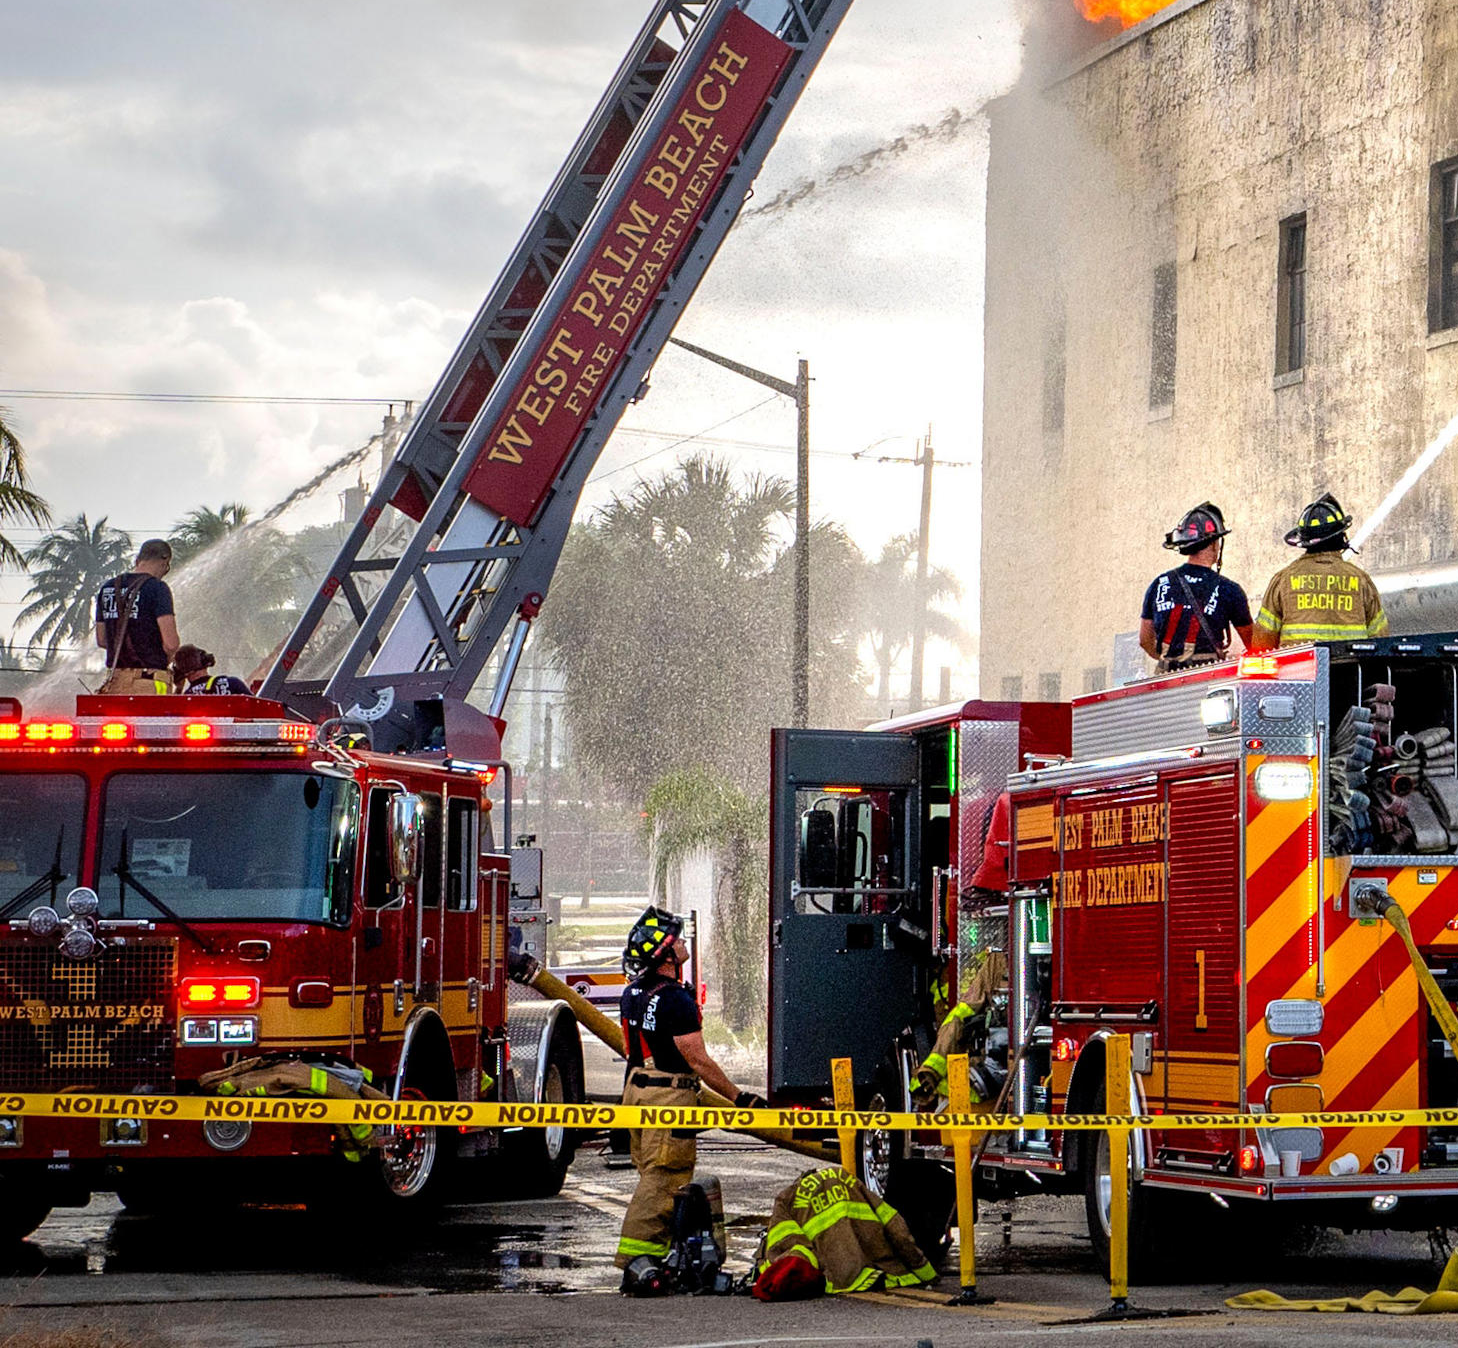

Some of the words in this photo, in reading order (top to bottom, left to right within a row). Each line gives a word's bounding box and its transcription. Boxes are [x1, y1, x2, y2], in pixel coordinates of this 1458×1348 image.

[488, 328, 584, 467] WEST
[572, 198, 659, 328] PALM
[644, 41, 750, 203] BEACH
[563, 341, 619, 418] FIRE
[608, 134, 730, 338] DEPARTMENT
[321, 576, 340, 599] 50
[1297, 593, 1334, 610] BEACH
[281, 649, 299, 672] 45
[1052, 813, 1084, 852] WEST
[1090, 807, 1123, 849] PALM
[1130, 802, 1172, 844] BEACH
[1052, 869, 1083, 909] FIRE
[1195, 949, 1208, 1029] 1
[0, 1006, 46, 1019] WEST
[51, 1005, 100, 1019] PALM
[104, 1005, 165, 1018] BEACH
[52, 1097, 179, 1116] CAUTION
[204, 1100, 329, 1118] CAUTION
[353, 1103, 474, 1122] CAUTION
[497, 1106, 616, 1124] CAUTION
[640, 1108, 755, 1126] CAUTION
[778, 1111, 892, 1127] CAUTION
[915, 1113, 1025, 1127] CAUTION
[1047, 1114, 1154, 1126] CAUTION
[1175, 1115, 1281, 1126] CAUTION
[1302, 1112, 1405, 1124] CAUTION
[792, 1174, 820, 1209] WEST
[810, 1184, 850, 1214] BEACH
